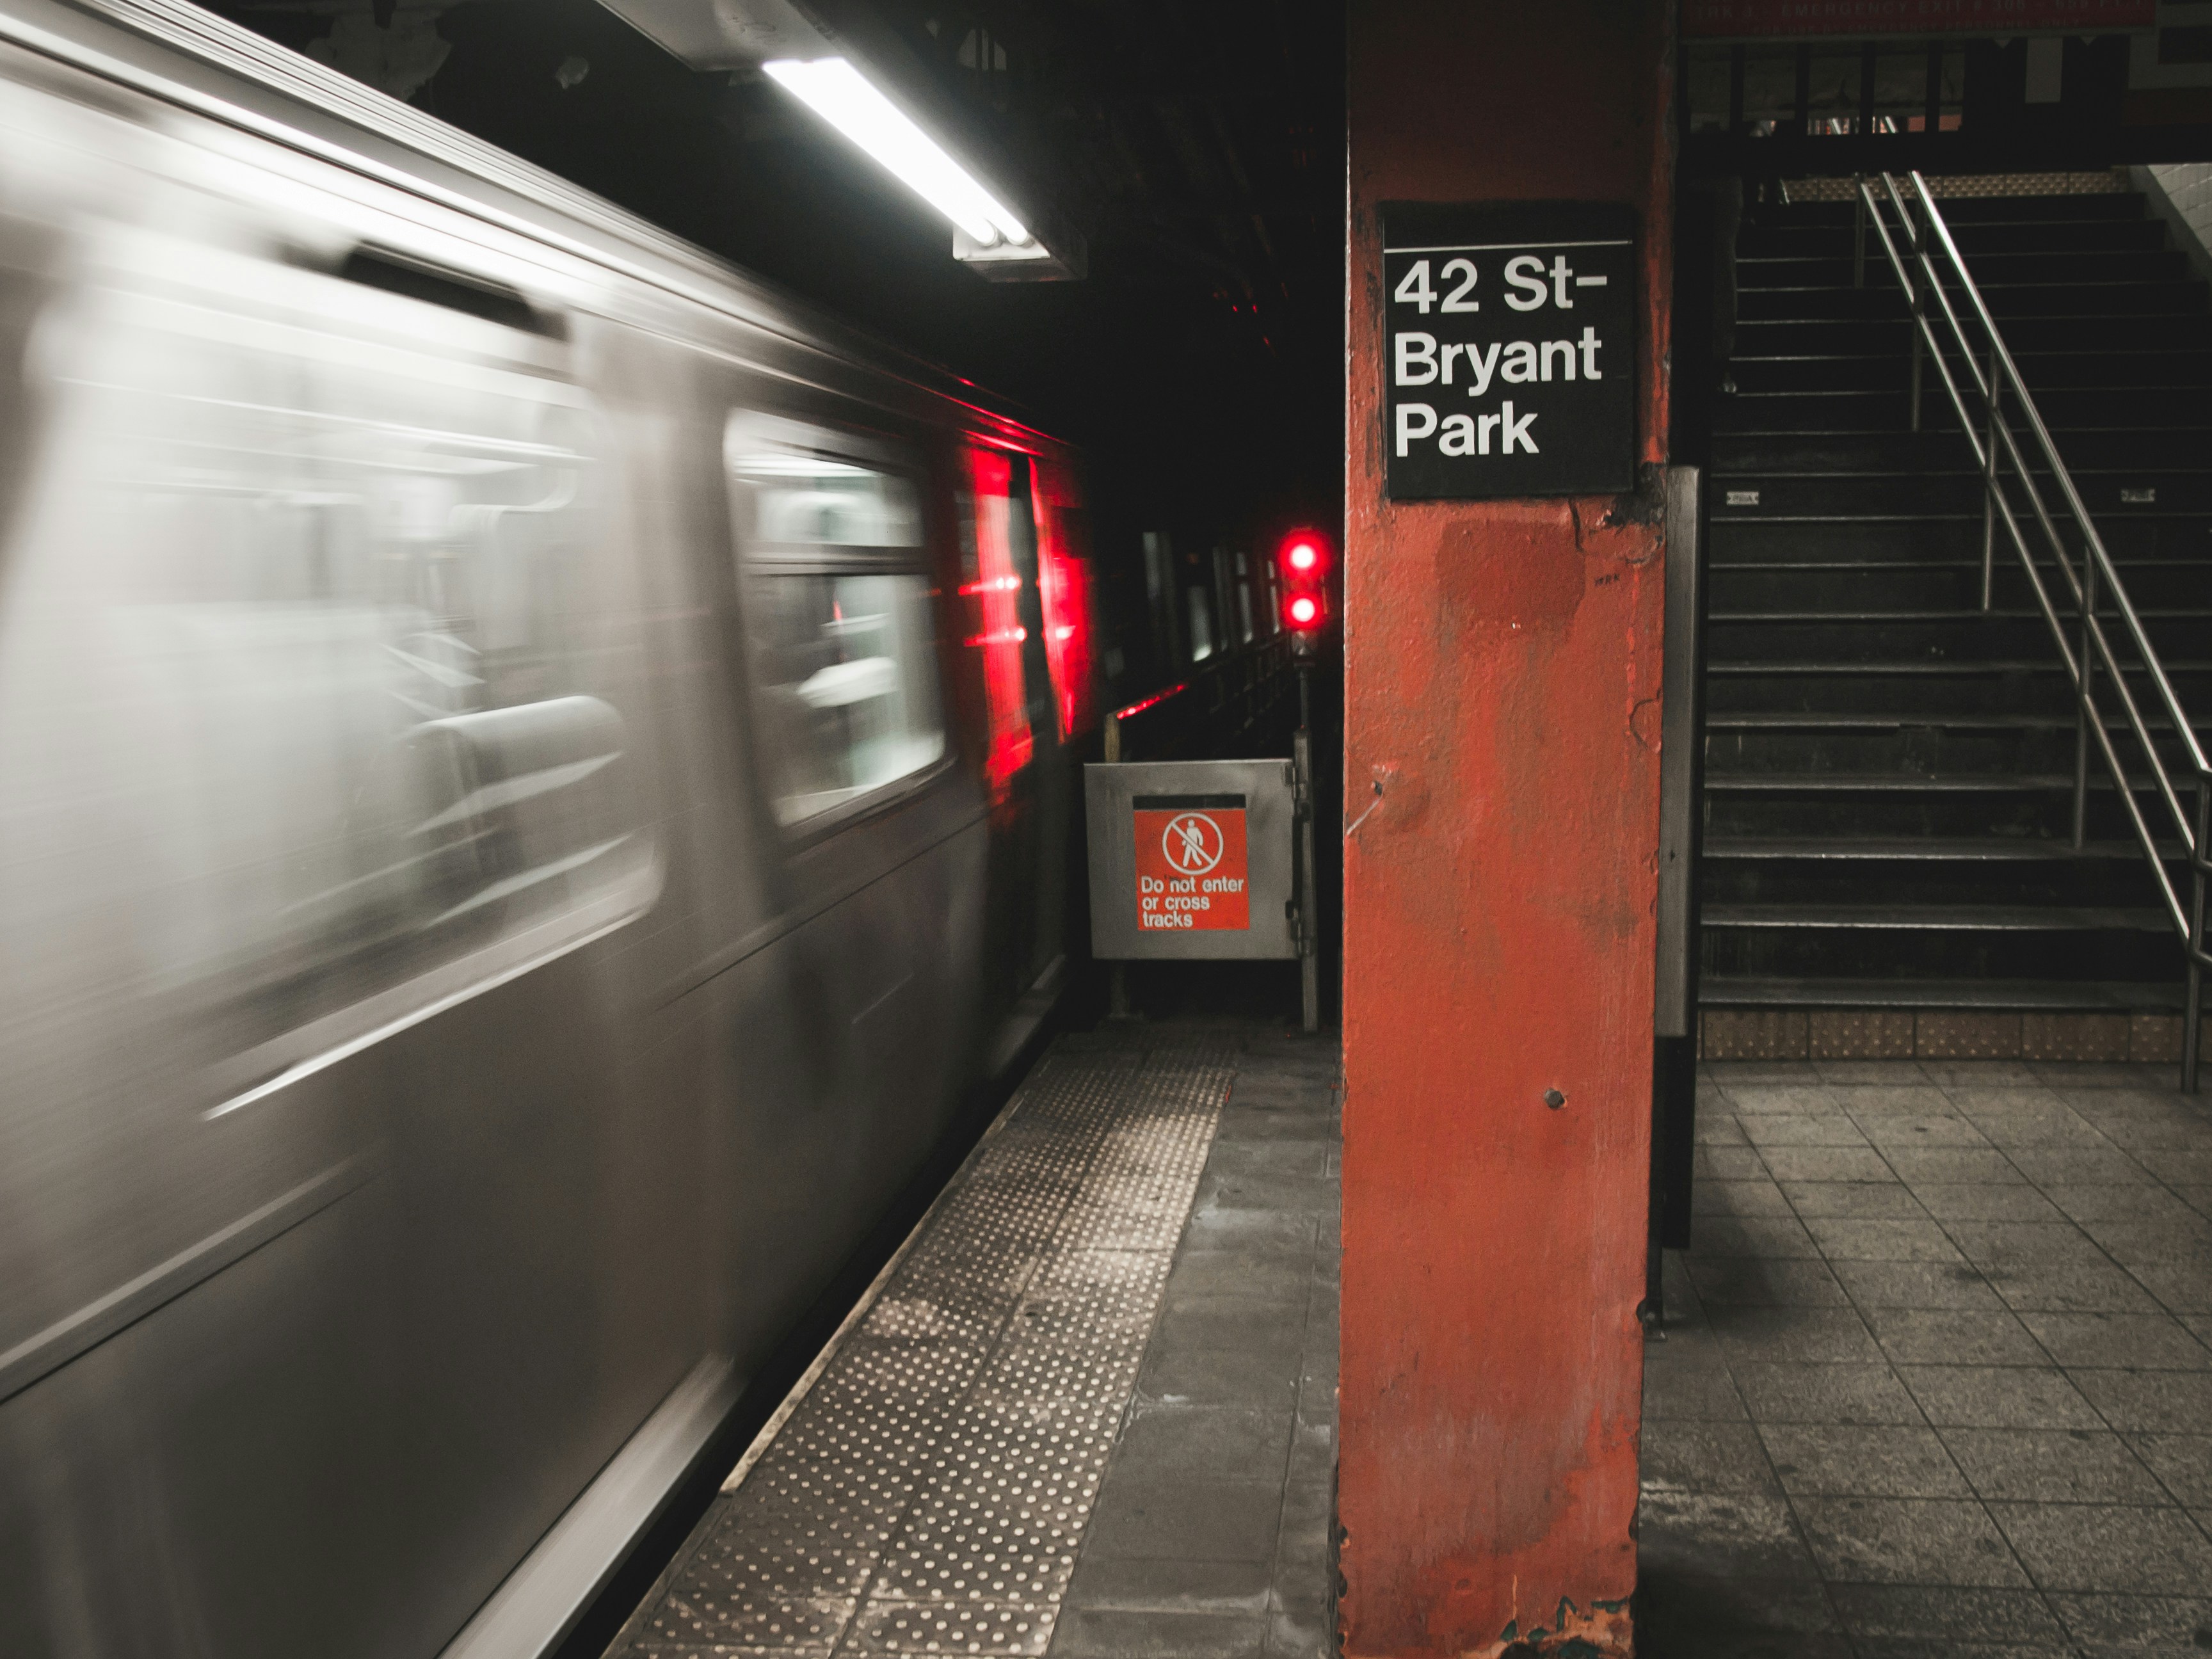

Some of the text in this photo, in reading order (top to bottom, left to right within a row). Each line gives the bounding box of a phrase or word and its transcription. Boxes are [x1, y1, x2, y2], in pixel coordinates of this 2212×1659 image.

[1781, 1, 1907, 17] EMERGENCY
[1918, 0, 1961, 14] EXIT
[1395, 255, 1607, 314] 42 St-
[1395, 327, 1601, 396] Bryant
[1396, 401, 1539, 457] Park
[1141, 876, 1244, 893] Do not enter
[1142, 896, 1210, 911] or cross
[1143, 910, 1193, 928] tracks
